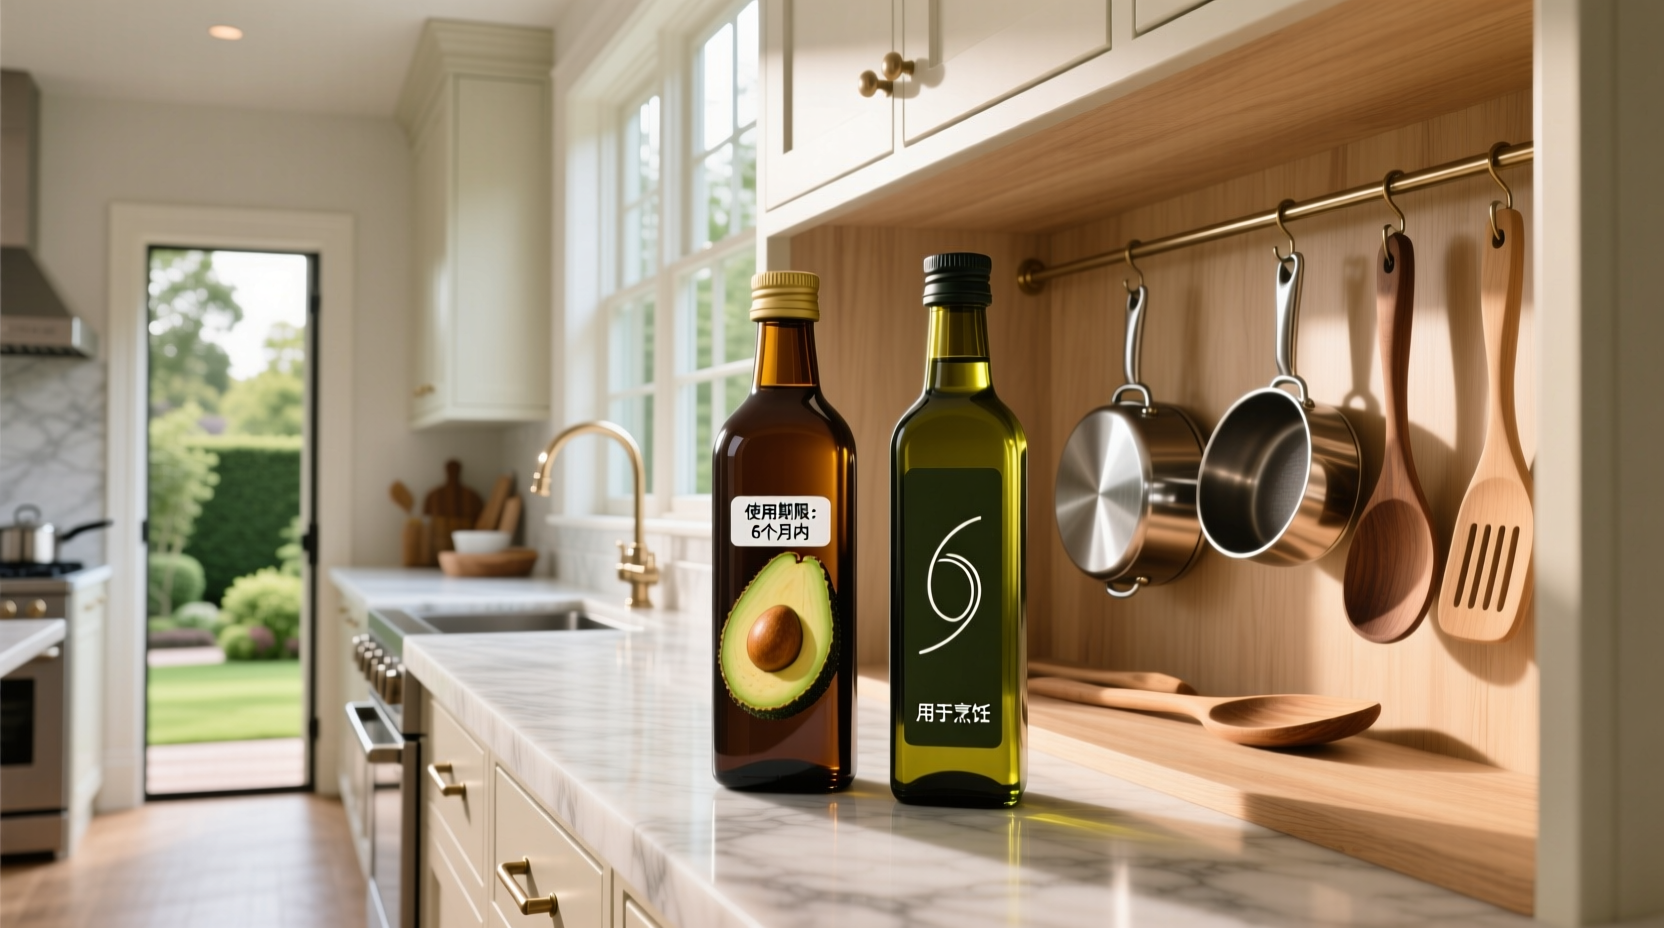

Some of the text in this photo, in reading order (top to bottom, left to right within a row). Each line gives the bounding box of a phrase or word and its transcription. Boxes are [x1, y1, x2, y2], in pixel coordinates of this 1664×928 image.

[752, 523, 809, 541] 6个月内
[916, 702, 991, 724] 用于烹饪
